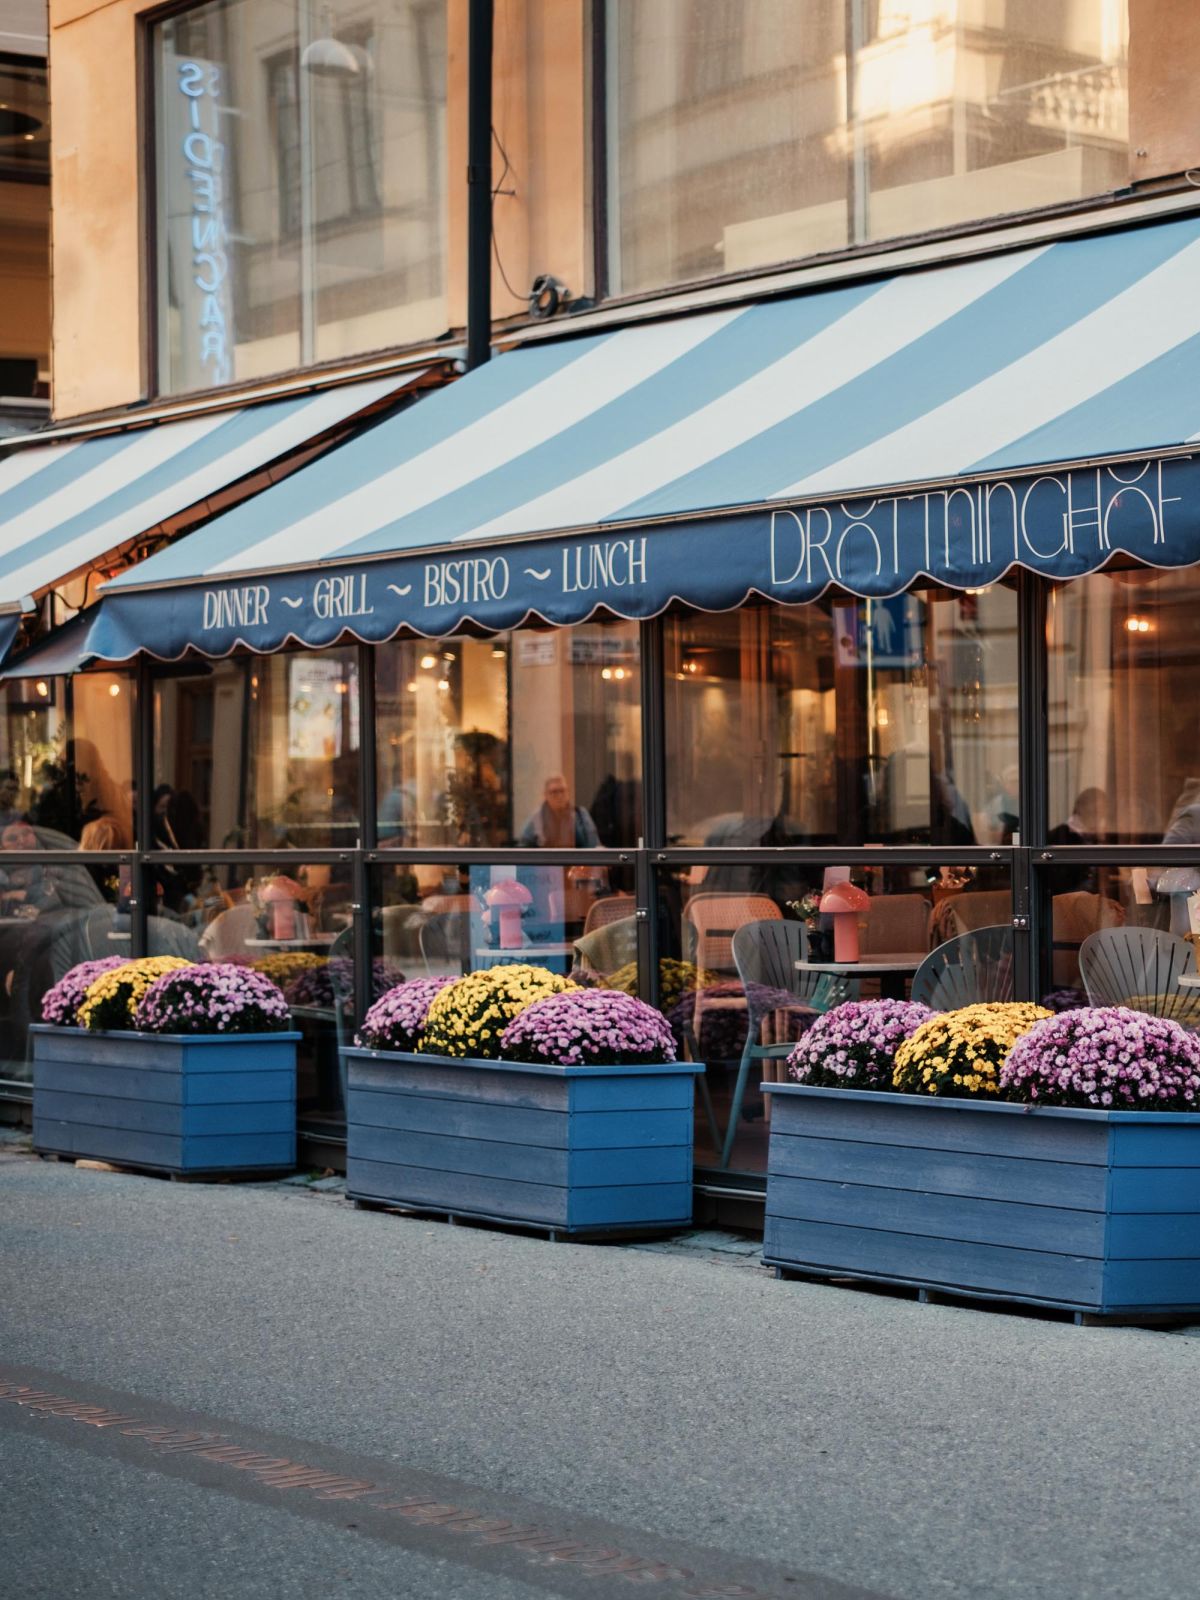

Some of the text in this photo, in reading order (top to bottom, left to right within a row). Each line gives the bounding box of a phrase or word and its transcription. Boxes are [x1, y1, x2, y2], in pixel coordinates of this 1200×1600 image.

[202, 537, 649, 631] DINNER GRILL BISTRO LUNCH
